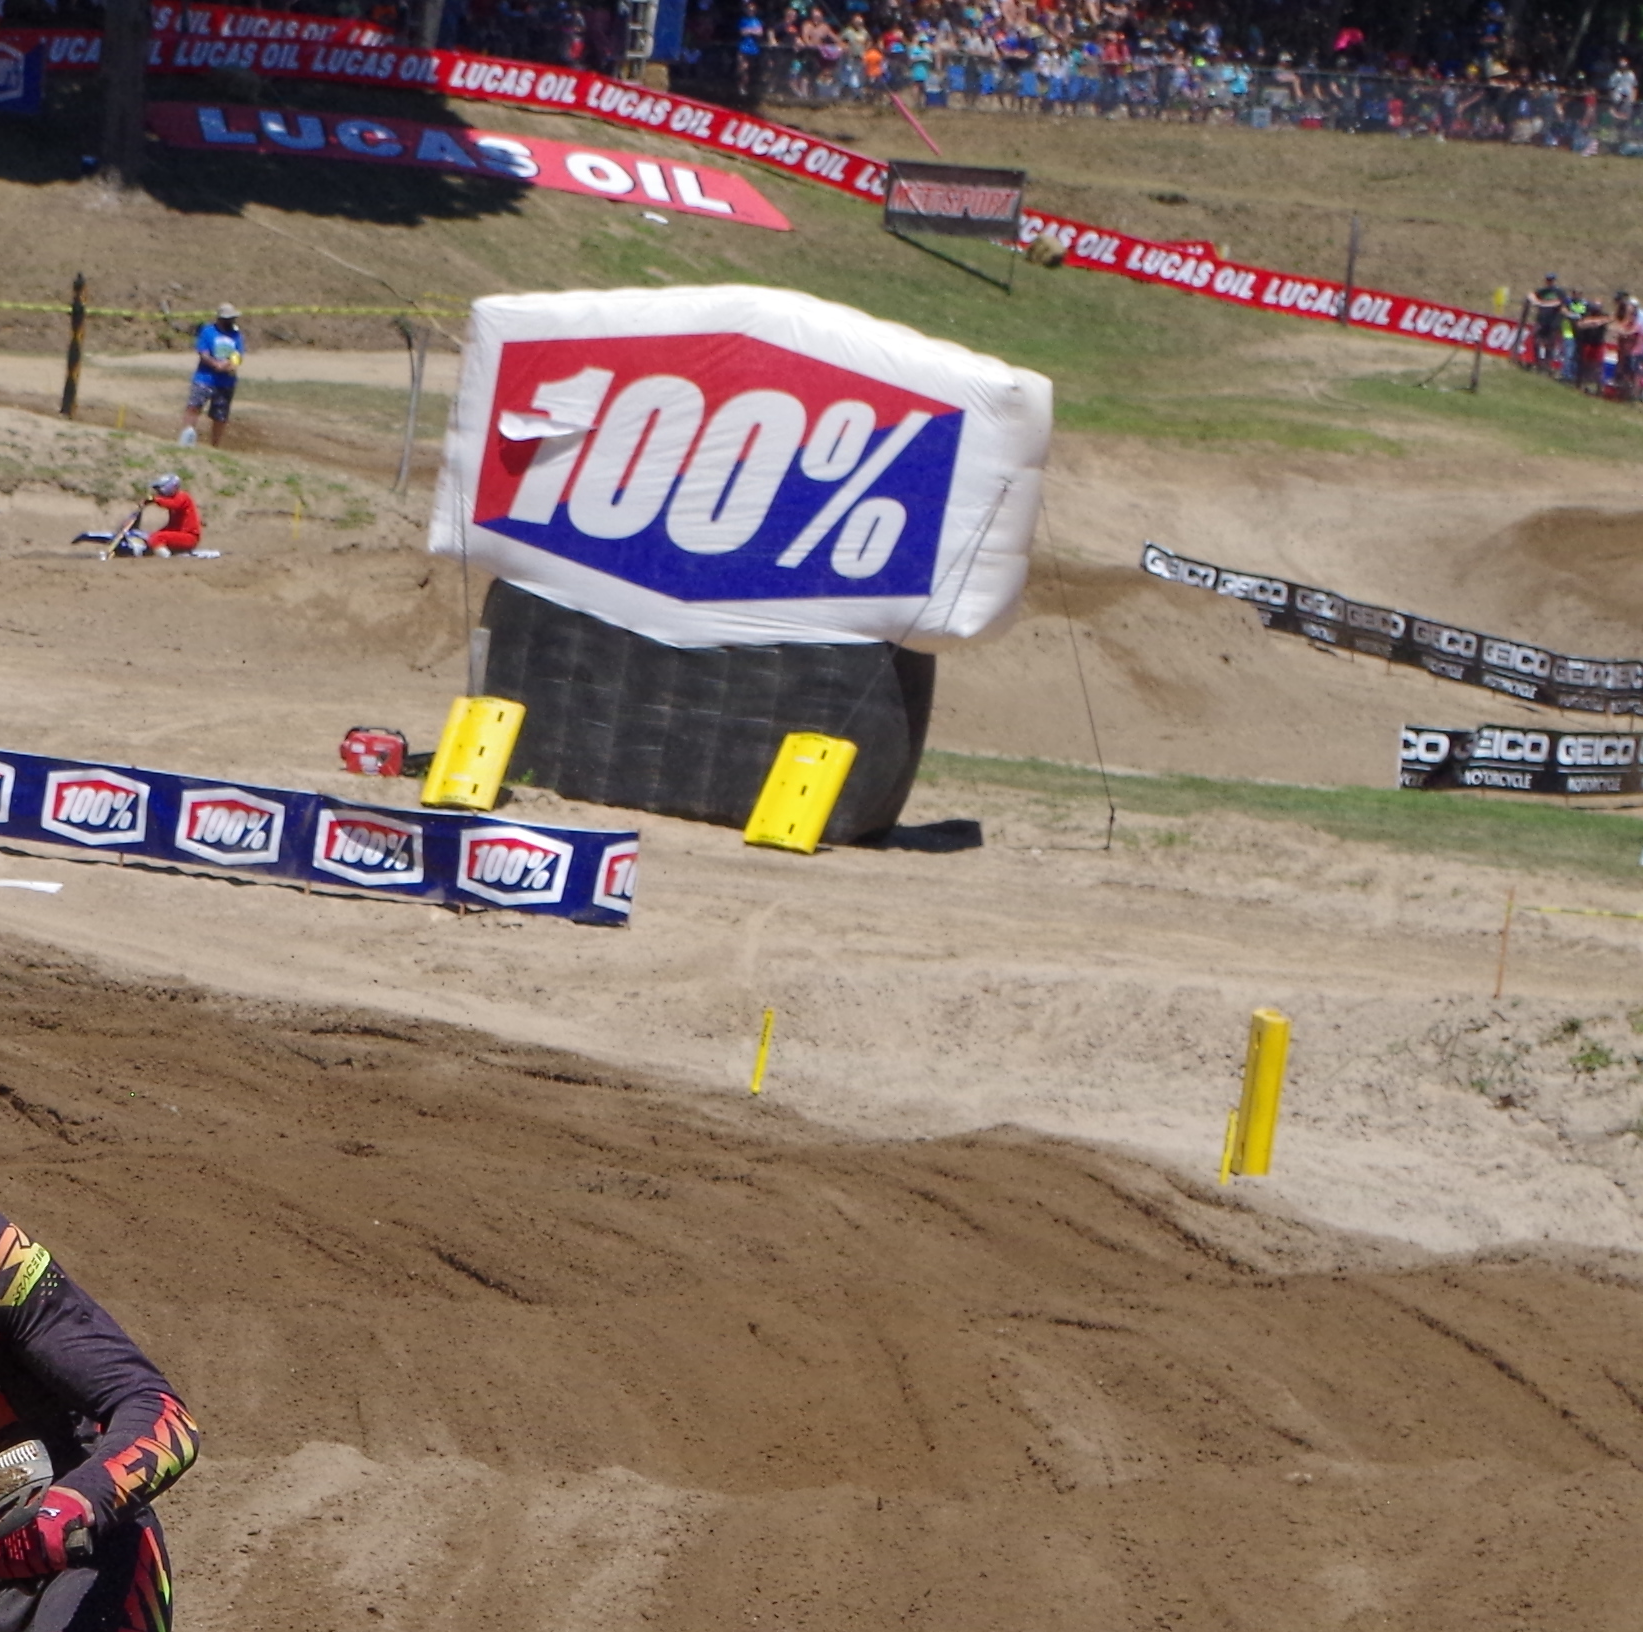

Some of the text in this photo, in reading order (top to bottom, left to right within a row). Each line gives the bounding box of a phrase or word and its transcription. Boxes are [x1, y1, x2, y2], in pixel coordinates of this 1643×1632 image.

[173, 40, 256, 69] LUCAS
[261, 43, 298, 69] OIL
[315, 45, 438, 84] LUCAS OIL
[448, 60, 576, 104] LUCAS OIL
[586, 81, 712, 138] LUCAS OIL
[198, 107, 735, 214] LUCAS OIL
[720, 117, 807, 169] LUCAS
[805, 147, 846, 183] OIL
[1077, 229, 1119, 263] OIL
[1125, 243, 1257, 301] LUCAS OIL
[1262, 277, 1390, 325] LUCAS OIL
[1399, 305, 1485, 345] LUCAS
[497, 366, 934, 579] 100%
[1216, 573, 1288, 606] GEICO
[1413, 620, 1476, 660] GEICO
[1481, 638, 1552, 679] GEICO
[1557, 735, 1636, 766] GEICO
[58, 786, 137, 830] 100%
[193, 805, 271, 850] 100%
[332, 823, 409, 871] 100%
[475, 844, 555, 890] 100%
